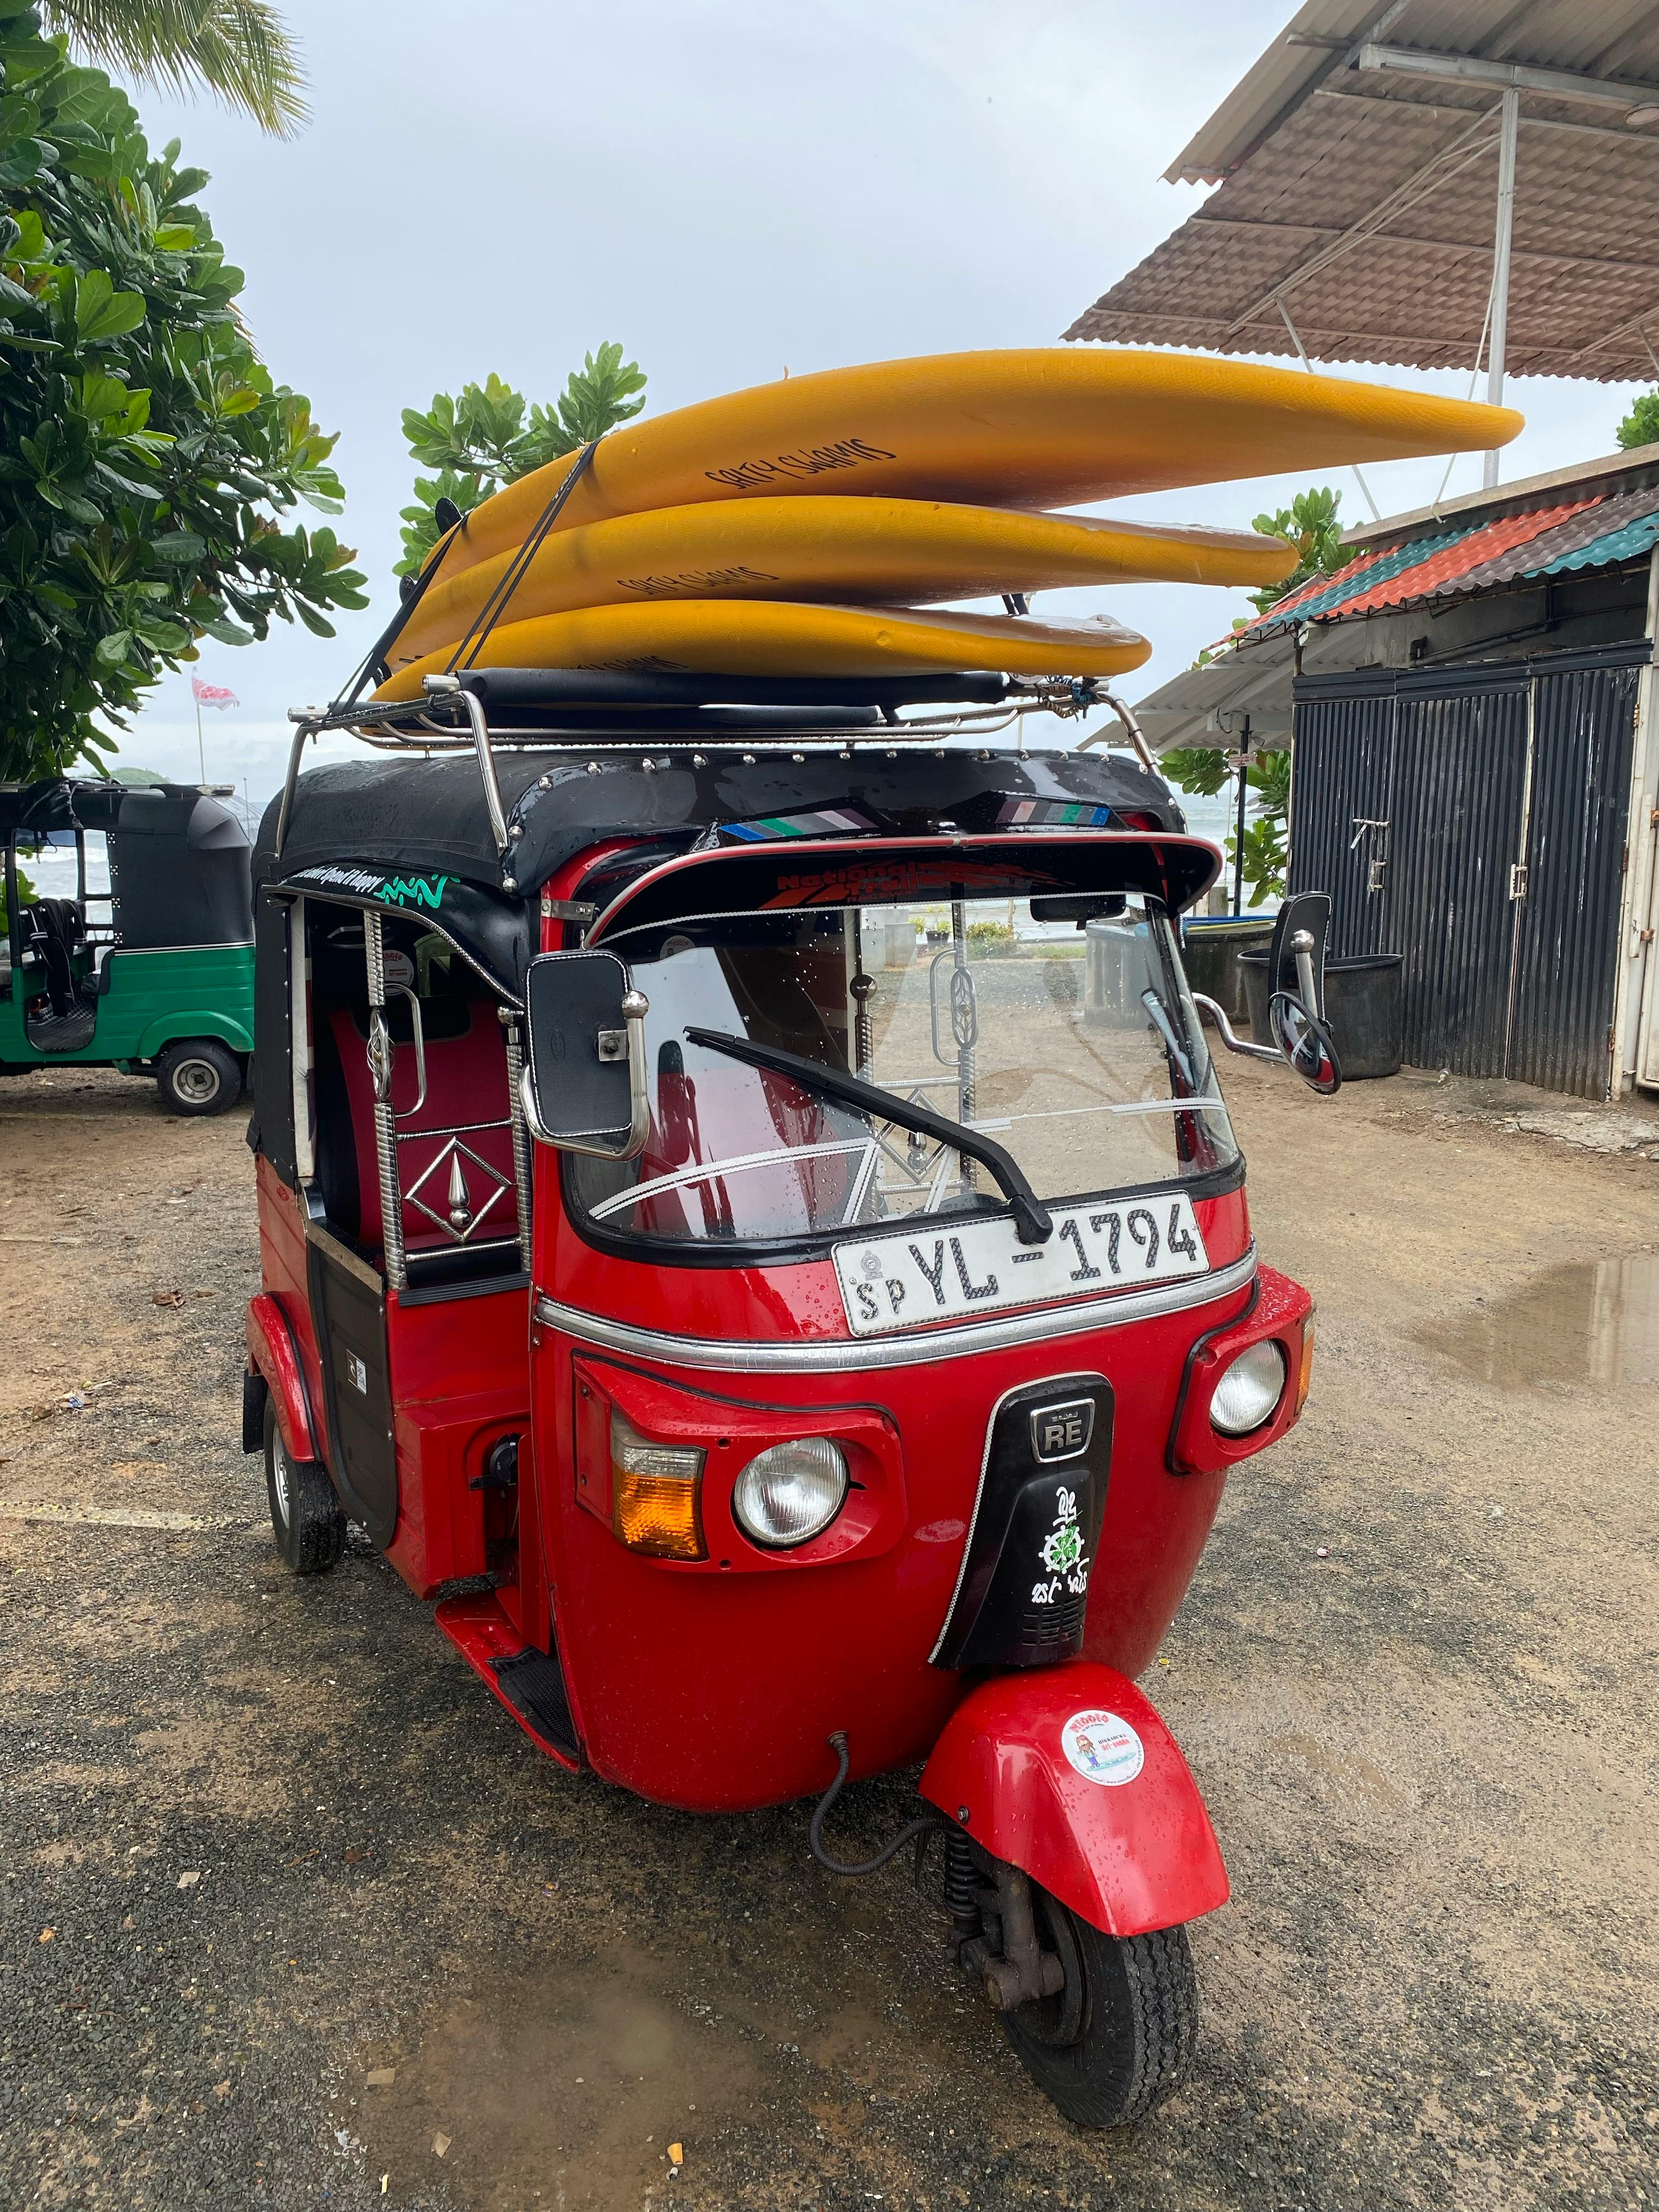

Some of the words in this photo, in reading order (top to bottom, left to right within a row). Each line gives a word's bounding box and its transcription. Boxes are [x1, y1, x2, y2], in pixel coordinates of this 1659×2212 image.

[704, 459, 805, 489] SALTY
[778, 438, 897, 474] SWAMIS
[777, 861, 917, 890] National
[845, 875, 917, 896] Trail
[1044, 1419, 1082, 1451] RE
